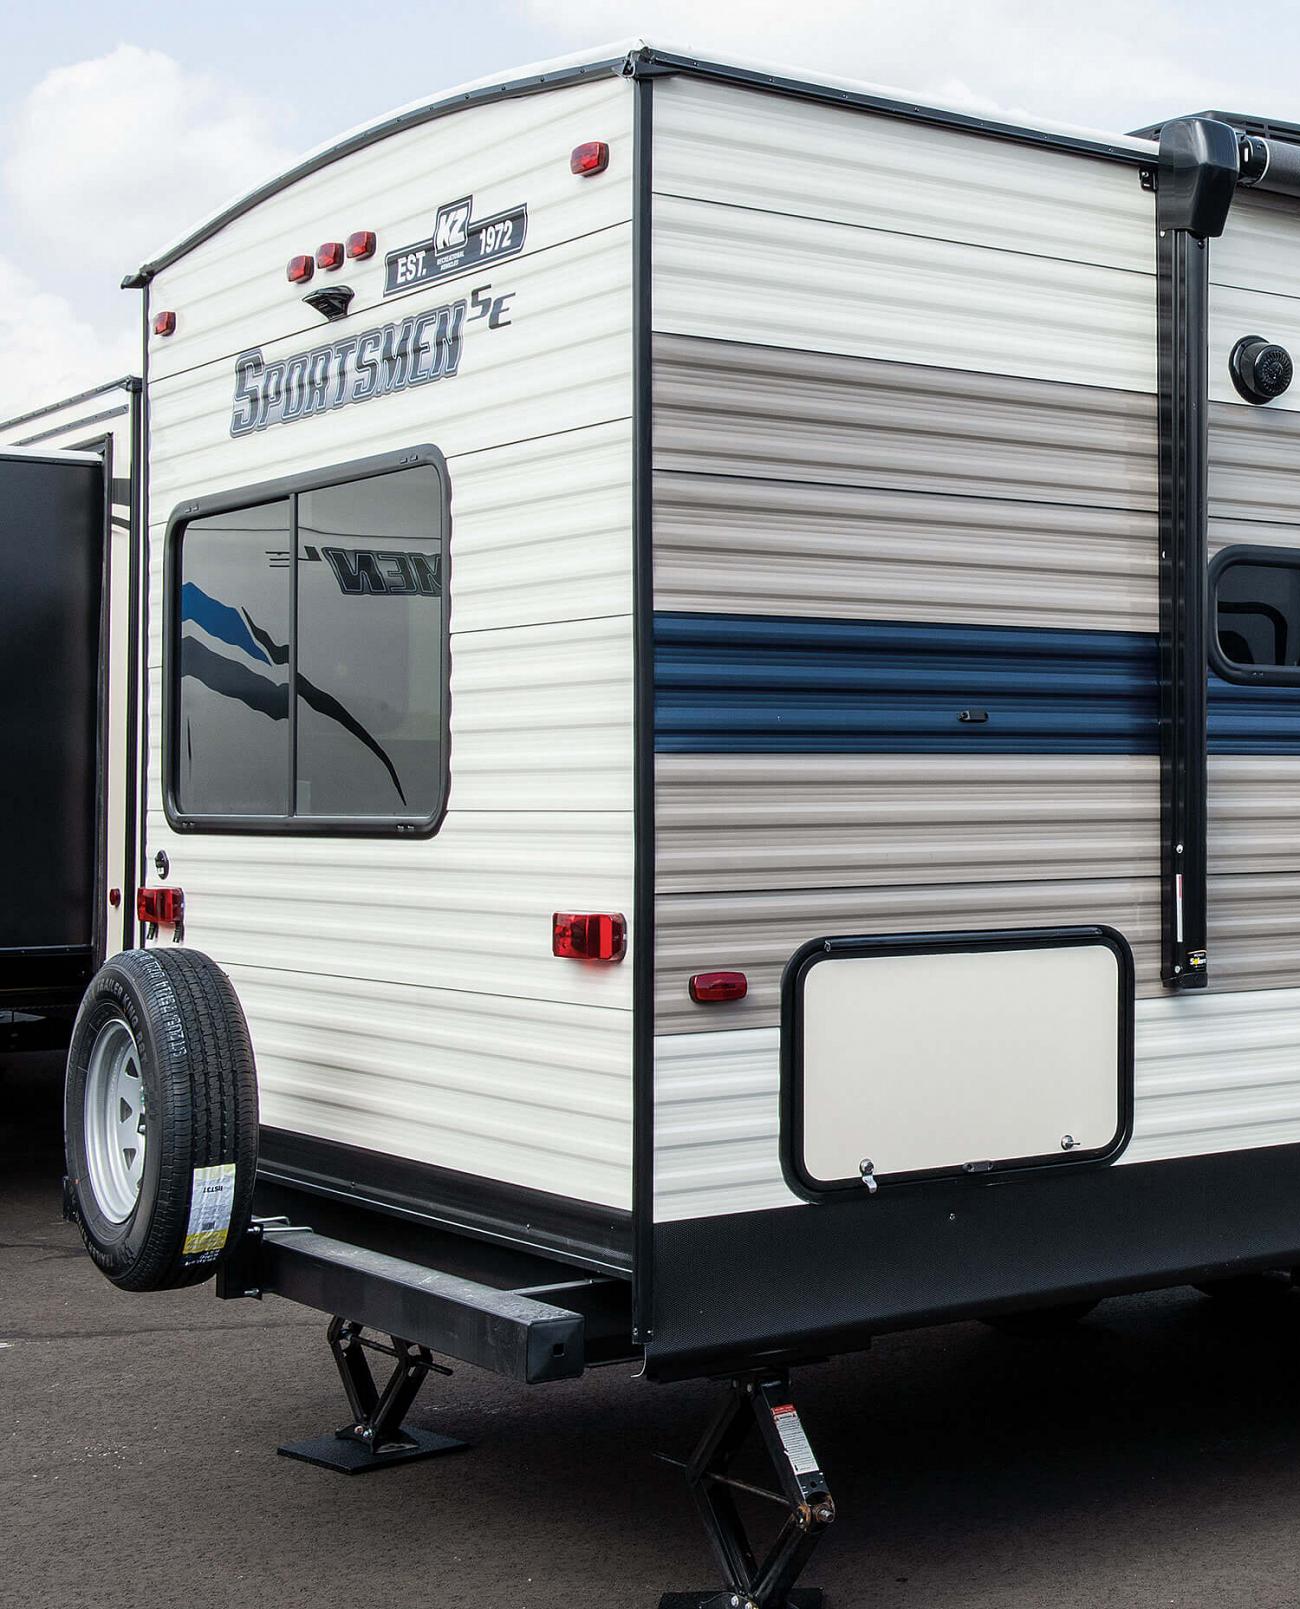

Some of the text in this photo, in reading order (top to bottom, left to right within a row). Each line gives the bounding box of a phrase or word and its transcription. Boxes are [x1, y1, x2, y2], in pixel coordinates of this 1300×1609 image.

[397, 220, 513, 284] EST. 1972
[436, 206, 468, 250] KZ
[229, 284, 516, 438] SPORTSMEN SE
